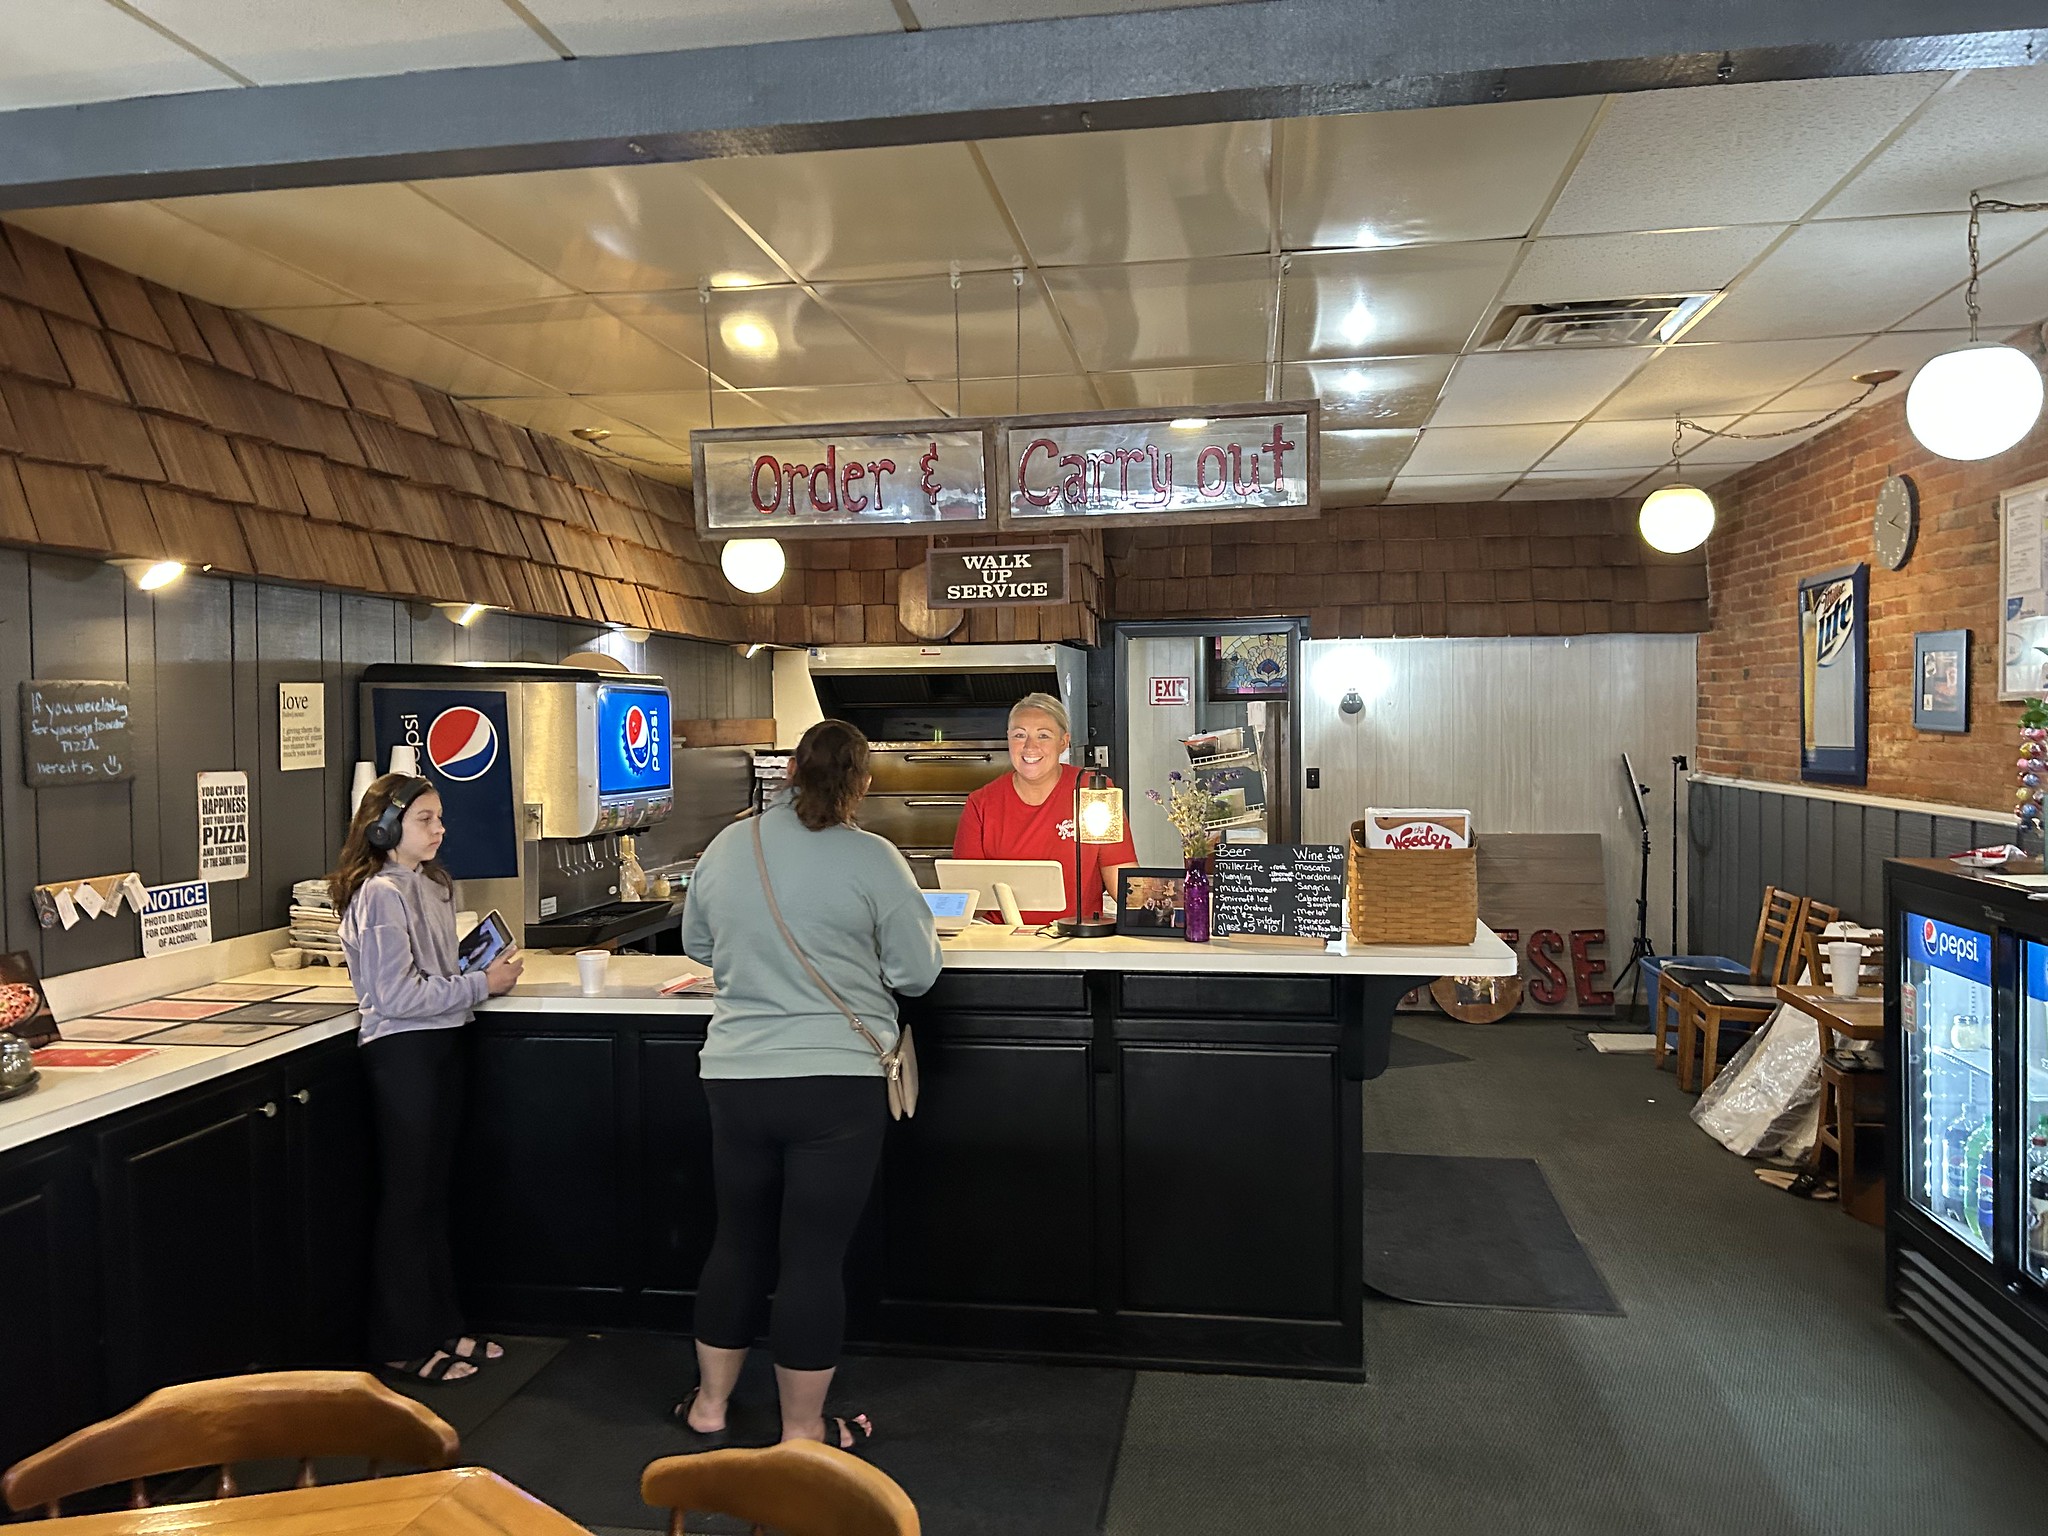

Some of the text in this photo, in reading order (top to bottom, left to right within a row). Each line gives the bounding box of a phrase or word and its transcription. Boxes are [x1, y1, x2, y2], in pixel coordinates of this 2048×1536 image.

[750, 423, 1296, 515] Order & Carry out
[962, 554, 1032, 570] WALK
[981, 569, 1013, 584] UP
[947, 582, 1048, 600] SERVICE
[1817, 594, 1853, 662] Lite
[1155, 680, 1185, 697] EXIT
[32, 692, 42, 716] If
[45, 703, 73, 727] you
[282, 691, 308, 710] love
[649, 707, 661, 772] pepsi
[202, 785, 246, 797] YOU CAN'T BUY
[202, 797, 246, 815] HAPPINESS
[203, 814, 246, 826] BUT YOU CAN BUY
[202, 825, 246, 845] PIZZA
[1386, 825, 1452, 849] Wooden
[203, 844, 246, 857] AND THAT'S KIND
[1215, 843, 1251, 857] Beer
[1292, 847, 1324, 860] Wine
[203, 855, 246, 868] OF THE SAME THING
[145, 885, 205, 912] NOTICE
[1256, 895, 1269, 903] Ice
[144, 907, 208, 928] PHOTO ID REQUIRED
[145, 919, 208, 939] FOR CONSUMPTION
[158, 932, 198, 948] OF ALCOHOL
[1940, 932, 1978, 962] pepsi
